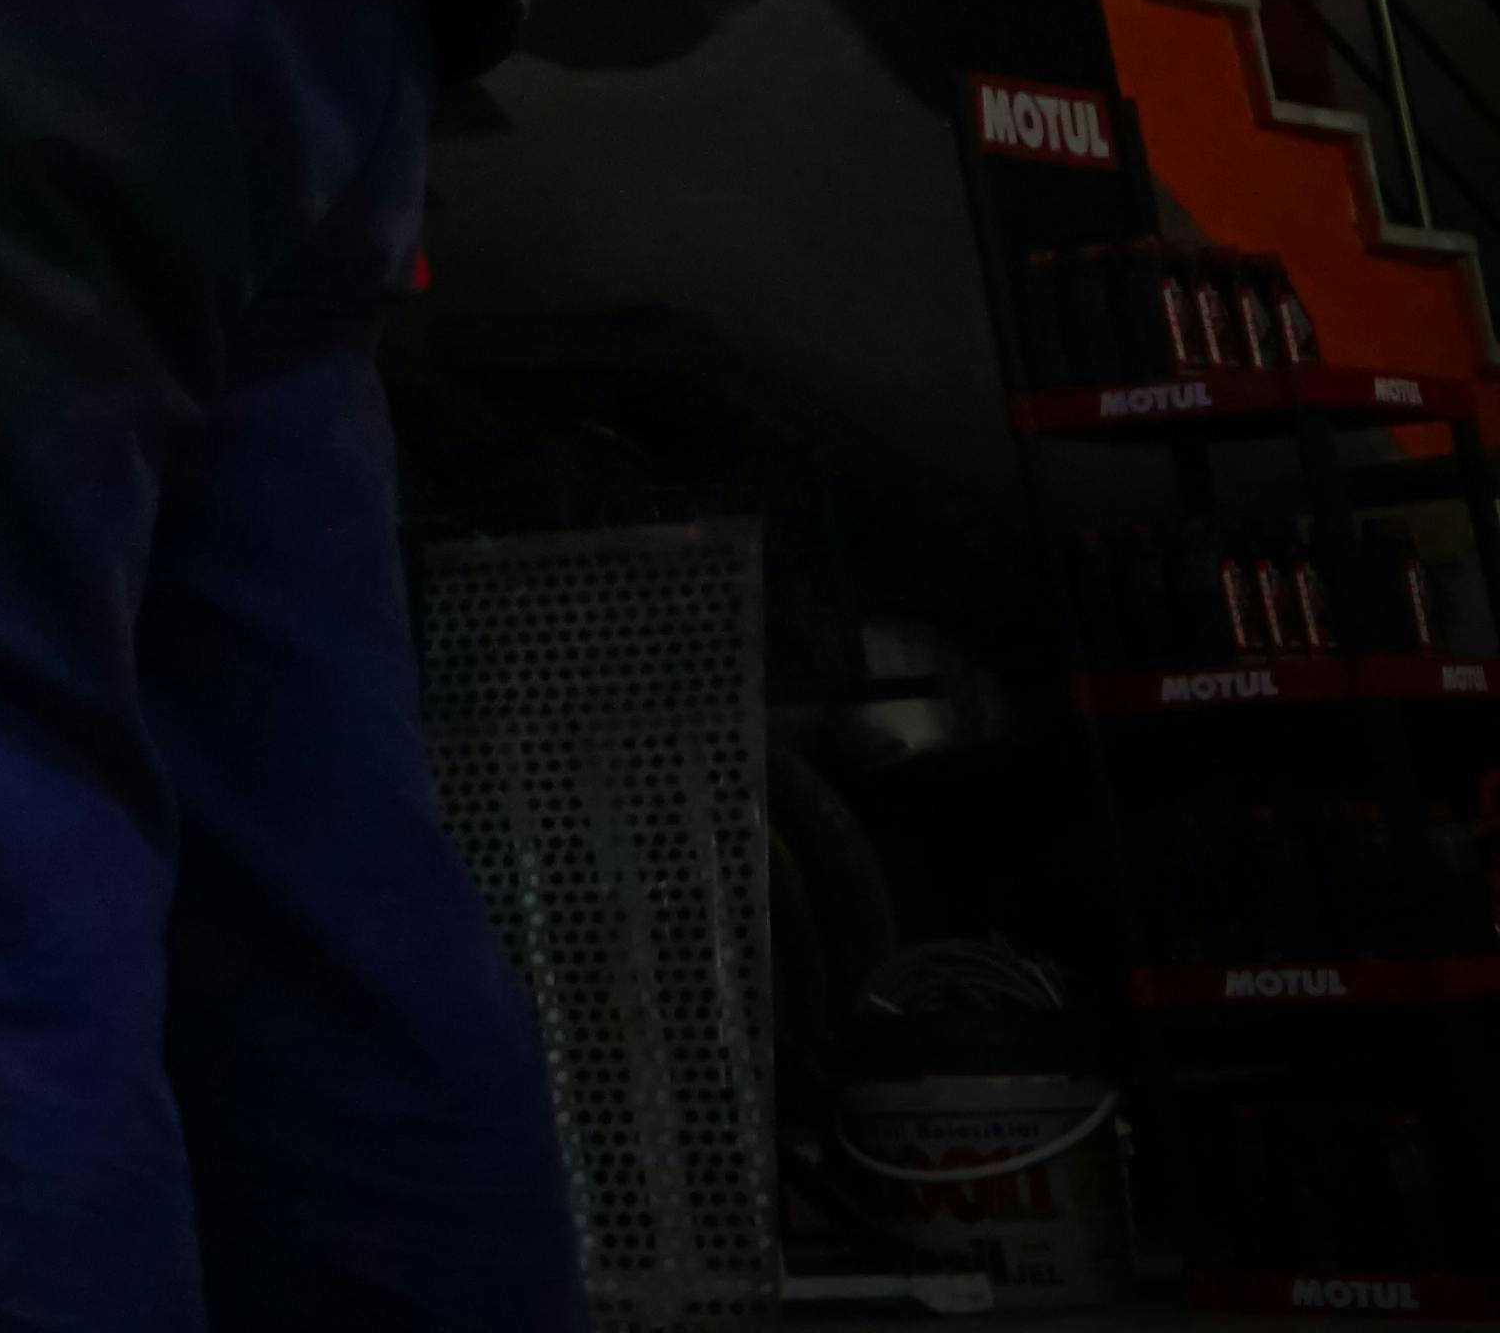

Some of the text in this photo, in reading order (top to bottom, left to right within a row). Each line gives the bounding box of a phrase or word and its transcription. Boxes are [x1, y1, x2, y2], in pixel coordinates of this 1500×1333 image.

[980, 85, 1110, 160] MOTUL
[1099, 380, 1213, 419] MOTUL
[1373, 375, 1424, 406] MOTUL
[1160, 669, 1279, 702] MOTUL
[1225, 968, 1348, 998] MOTUL
[1291, 1278, 1421, 1310] MOTUL
